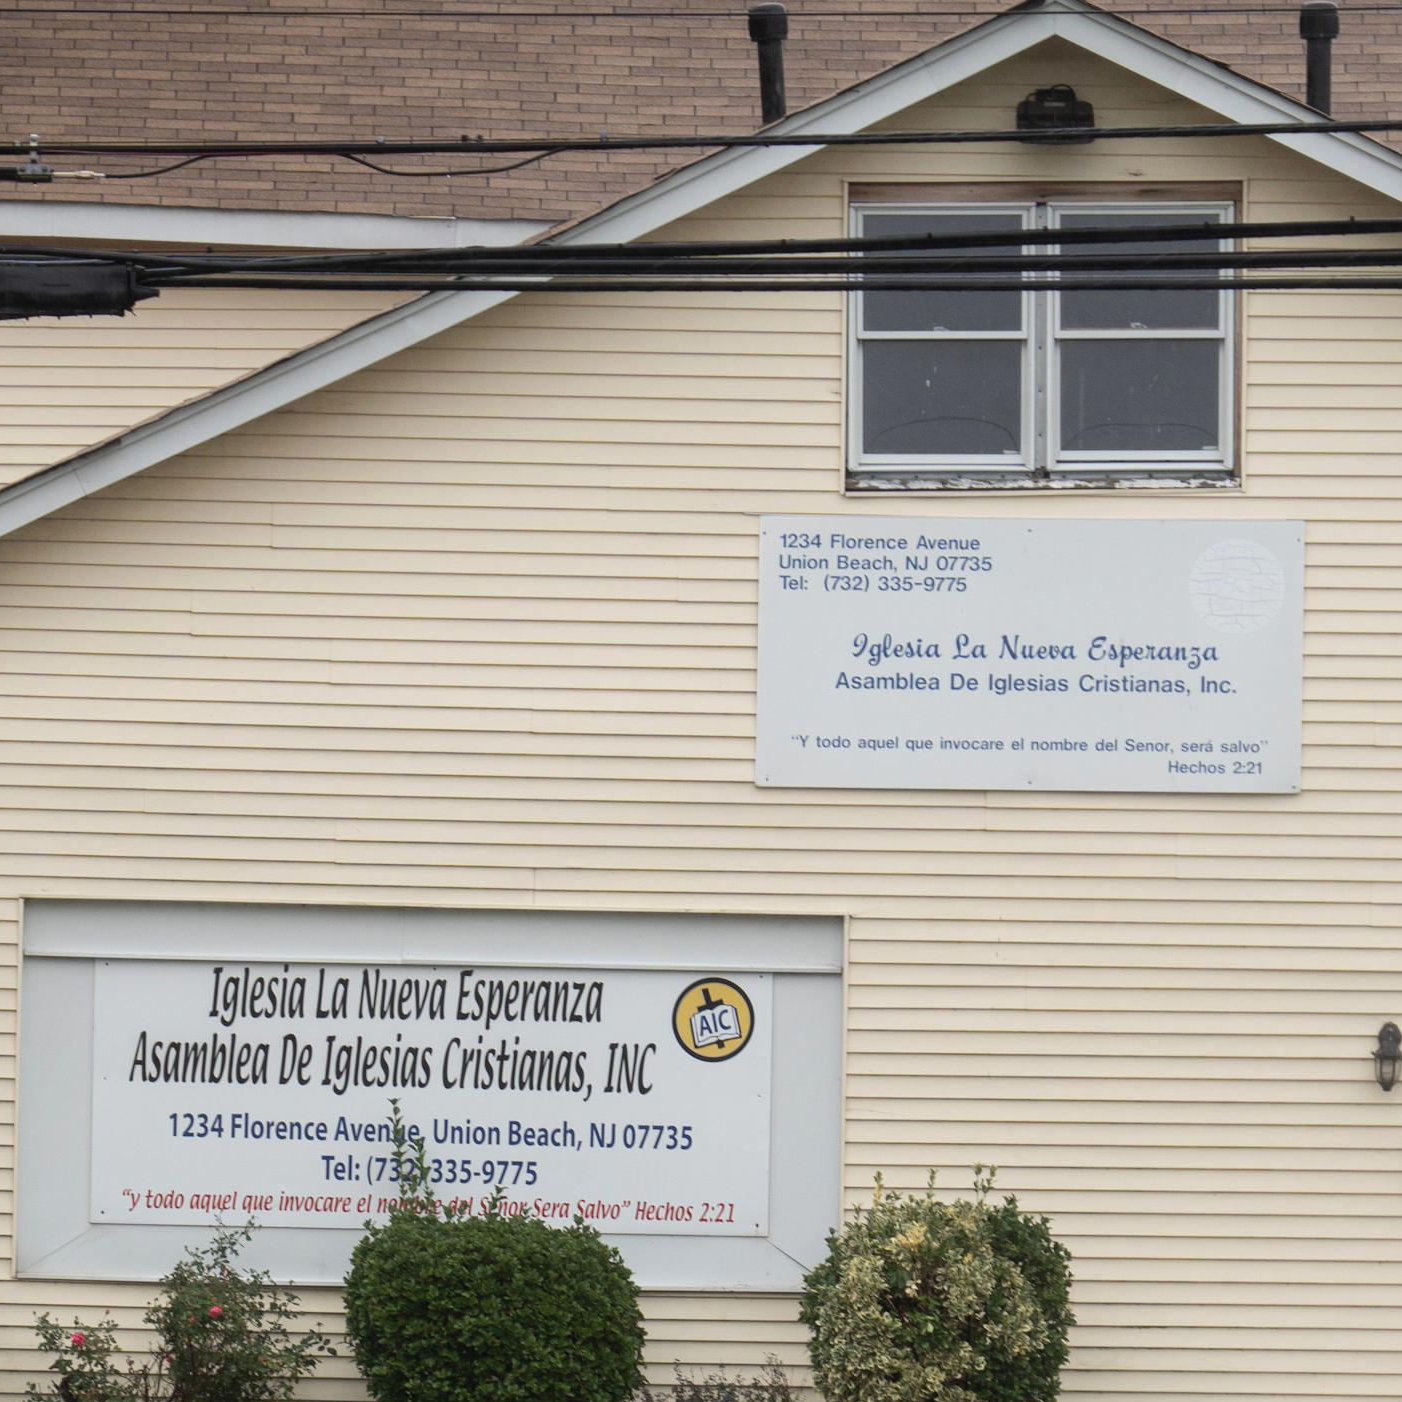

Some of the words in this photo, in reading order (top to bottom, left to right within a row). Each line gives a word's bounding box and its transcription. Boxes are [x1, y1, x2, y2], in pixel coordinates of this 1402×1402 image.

[780, 533, 823, 549] 1234
[830, 533, 908, 550] Florence
[916, 535, 981, 551] Avenue
[779, 554, 829, 570] Union
[837, 554, 898, 572] Beach,
[905, 555, 929, 571] NJ
[936, 555, 993, 572] 07735
[779, 574, 808, 591] Tel:
[823, 574, 870, 592] (732)
[877, 575, 967, 593] 335-9775
[852, 632, 941, 667] Iglesia
[952, 633, 987, 660] La
[998, 634, 1077, 661] Nueva
[1087, 635, 1218, 670] Esperanza
[835, 671, 940, 691] Asamblea
[950, 672, 979, 691] De
[988, 673, 1069, 696] Iglesias
[1078, 674, 1191, 695] Cristianas,
[1200, 675, 1237, 694] Inc.
[816, 735, 851, 749] todo
[857, 736, 899, 751] aquel
[905, 739, 934, 752] que
[940, 736, 1004, 751] invocare
[1010, 738, 1024, 751] el
[1030, 738, 1089, 752] nombre
[1094, 739, 1118, 752] del
[1124, 738, 1174, 753] Senor,
[1168, 760, 1226, 774] Hechos
[1233, 761, 1262, 774] 2:21
[209, 964, 307, 1028] Iglesia
[315, 968, 350, 1020] La
[357, 968, 448, 1021] Nueva
[455, 970, 604, 1030] Esperanza
[700, 1009, 731, 1036] AIC
[128, 1030, 271, 1085] Asamblea
[278, 1032, 314, 1087] De
[320, 1033, 434, 1096] Iglesias
[441, 1034, 593, 1103] Cristianas,
[603, 1042, 658, 1096] INC
[169, 1112, 225, 1139] 1234
[230, 1112, 329, 1142] Florence
[433, 1118, 501, 1146] Union
[508, 1120, 583, 1152] Beach,
[589, 1122, 617, 1149] NJ
[622, 1124, 693, 1151] 07735
[320, 1154, 361, 1182] Tel:
[429, 1158, 538, 1186] 335-9775
[145, 1189, 185, 1209] todo
[189, 1191, 239, 1213] aquel
[241, 1194, 274, 1213] que
[278, 1191, 352, 1213] invocare
[356, 1194, 373, 1214] el
[477, 1195, 527, 1217] Sñor
[531, 1197, 570, 1219] Sera
[635, 1200, 694, 1223] Hechos
[698, 1202, 734, 1223] 2:21
